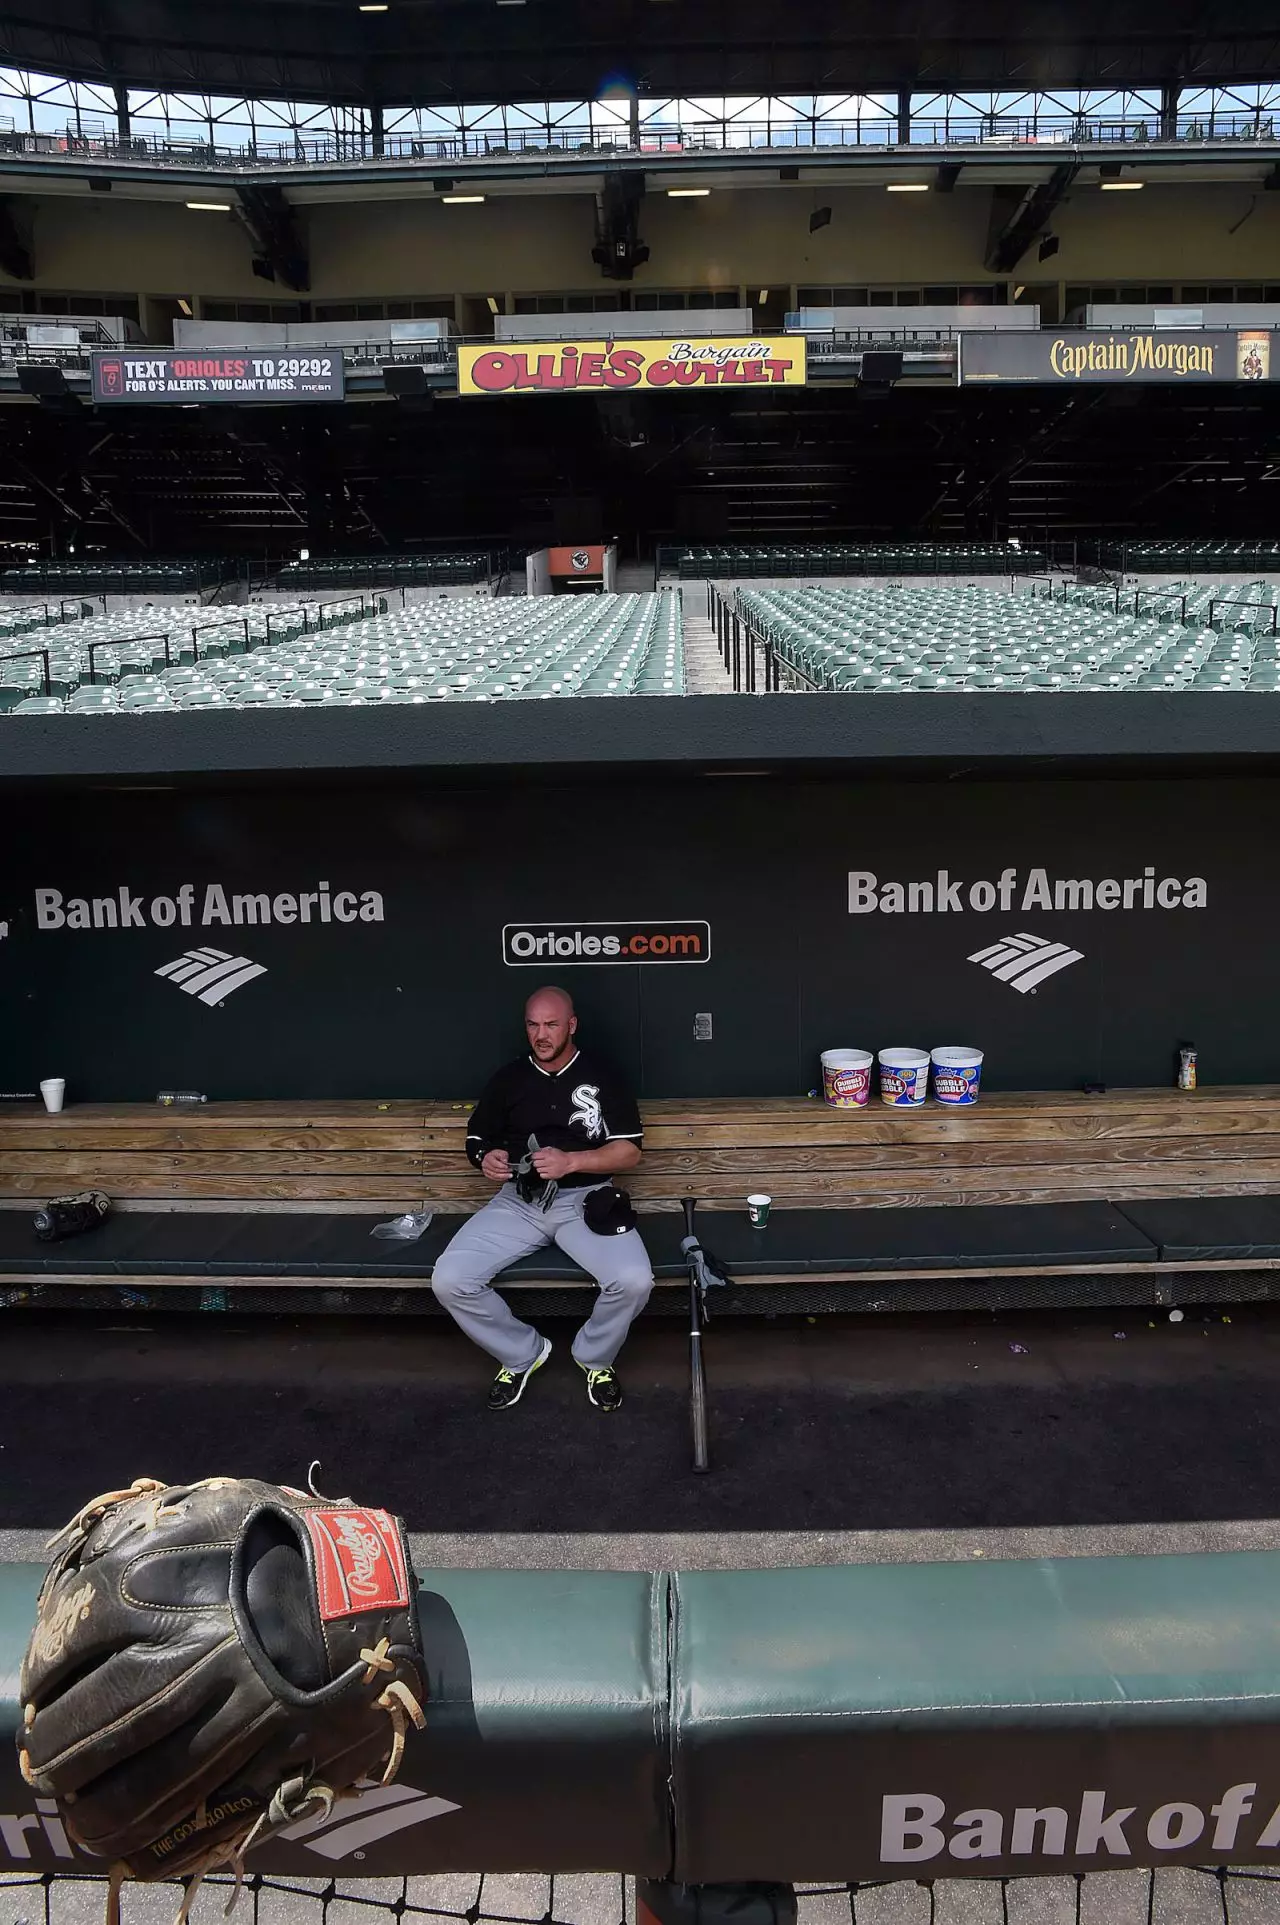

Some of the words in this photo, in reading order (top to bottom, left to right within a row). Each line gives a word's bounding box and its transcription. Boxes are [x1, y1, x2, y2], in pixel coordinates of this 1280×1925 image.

[124, 361, 167, 378] TEXT
[252, 359, 276, 377] TO
[278, 358, 332, 377] 29292
[471, 342, 646, 392] OLLIE'S
[669, 342, 771, 367] Bargain
[1050, 337, 1128, 378] Captain
[1126, 336, 1214, 376] Morgan
[125, 380, 147, 392] FOR
[148, 380, 166, 392] O'S
[167, 379, 210, 391] ALERTS.
[211, 379, 234, 391] YOU
[234, 378, 267, 391] CAN'T
[267, 378, 297, 390] MISS.
[646, 359, 793, 386] OUTLET
[35, 886, 146, 929] Bank
[151, 884, 195, 927] of
[201, 881, 385, 925] America
[848, 869, 964, 914] Bank
[969, 868, 1017, 911] of
[1021, 867, 1208, 911] America
[511, 931, 700, 957] Orioles.com
[879, 1790, 1137, 1862] Bank
[1146, 1782, 1257, 1850] of
